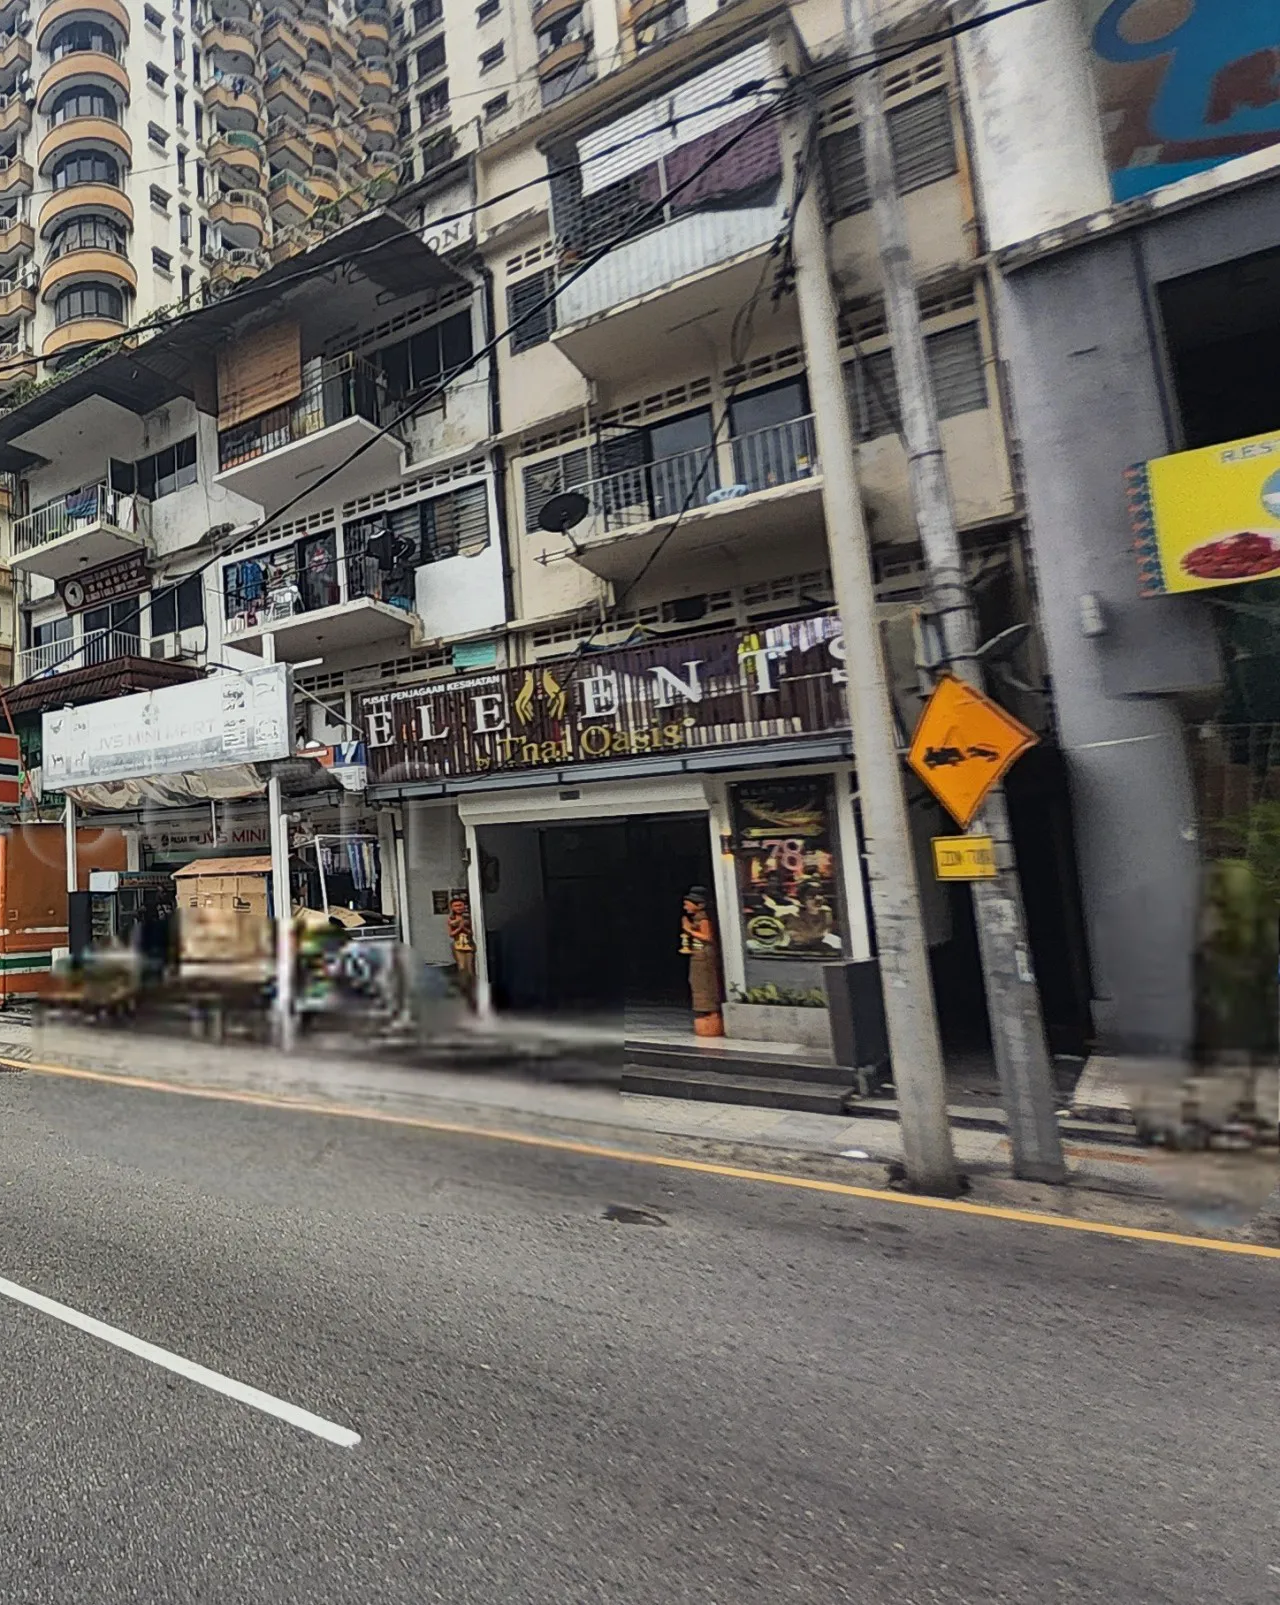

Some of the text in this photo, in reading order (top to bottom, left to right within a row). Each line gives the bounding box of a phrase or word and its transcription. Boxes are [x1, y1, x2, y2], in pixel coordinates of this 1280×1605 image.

[362, 674, 501, 706] PUSAT PENJAGAAN KESIHATAN
[580, 719, 685, 756] Oasis
[232, 828, 266, 843] MINI
